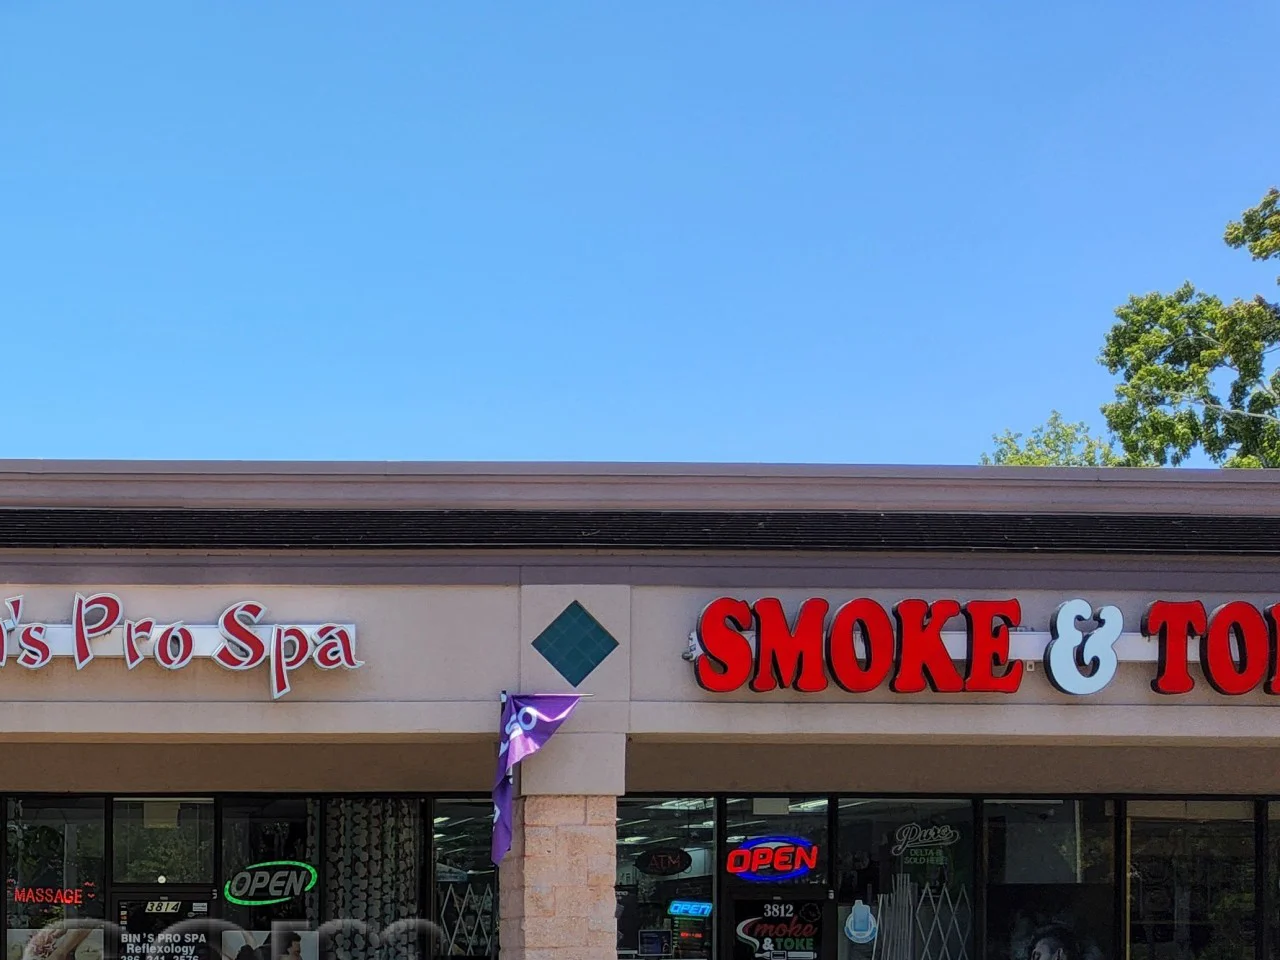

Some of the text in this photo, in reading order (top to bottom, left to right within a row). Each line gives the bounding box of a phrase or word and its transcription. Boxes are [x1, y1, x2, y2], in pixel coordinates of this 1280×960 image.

[72, 592, 196, 670] Pro
[212, 600, 365, 700] Spa
[695, 597, 1023, 694] SMOKE
[1044, 598, 1123, 696] &
[648, 854, 681, 868] ATM
[726, 846, 818, 873] OPEN
[230, 870, 306, 898] OPEN
[14, 887, 83, 904] MASSAGE
[147, 902, 179, 912] 3814
[670, 903, 712, 915] OPEN
[763, 903, 794, 917] 3812
[157, 934, 181, 943] PRO
[184, 934, 207, 943] SPA
[762, 937, 814, 951] & TOKE
[126, 943, 195, 956] Reflexology
